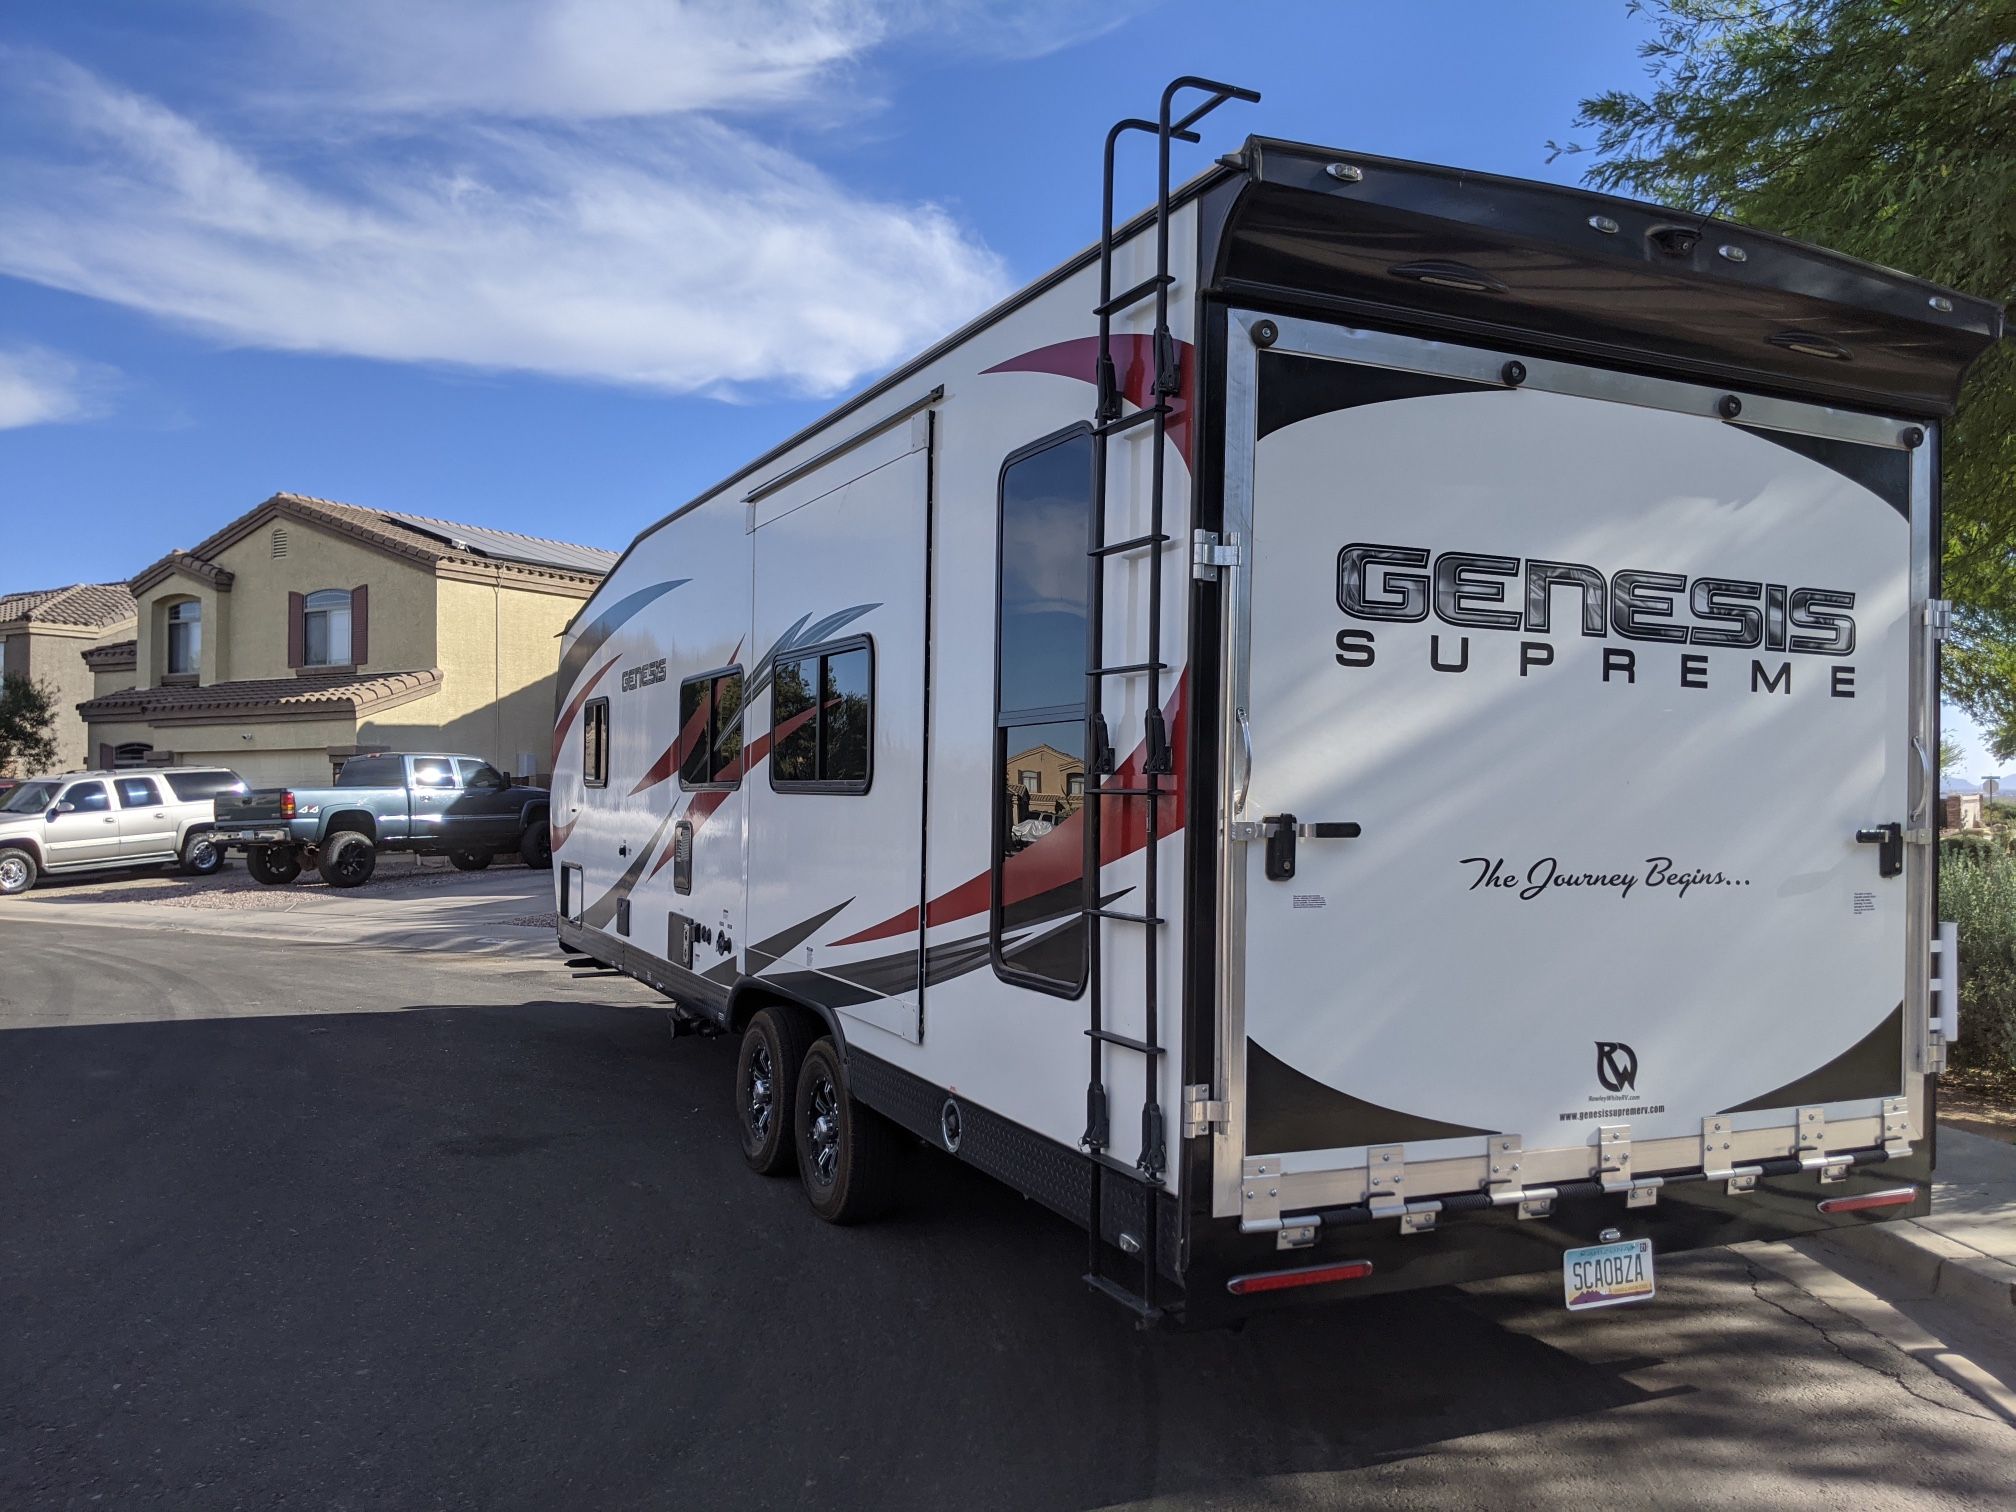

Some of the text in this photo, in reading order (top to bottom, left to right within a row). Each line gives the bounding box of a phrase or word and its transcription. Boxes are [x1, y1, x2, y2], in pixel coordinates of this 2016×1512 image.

[1336, 542, 1856, 657] GENESIS
[622, 658, 667, 692] GENESIS
[1335, 629, 1856, 699] SUPREME
[1459, 857, 1751, 900] The Journey Begins...
[1559, 1104, 1665, 1121] www.genesissupremerv.com
